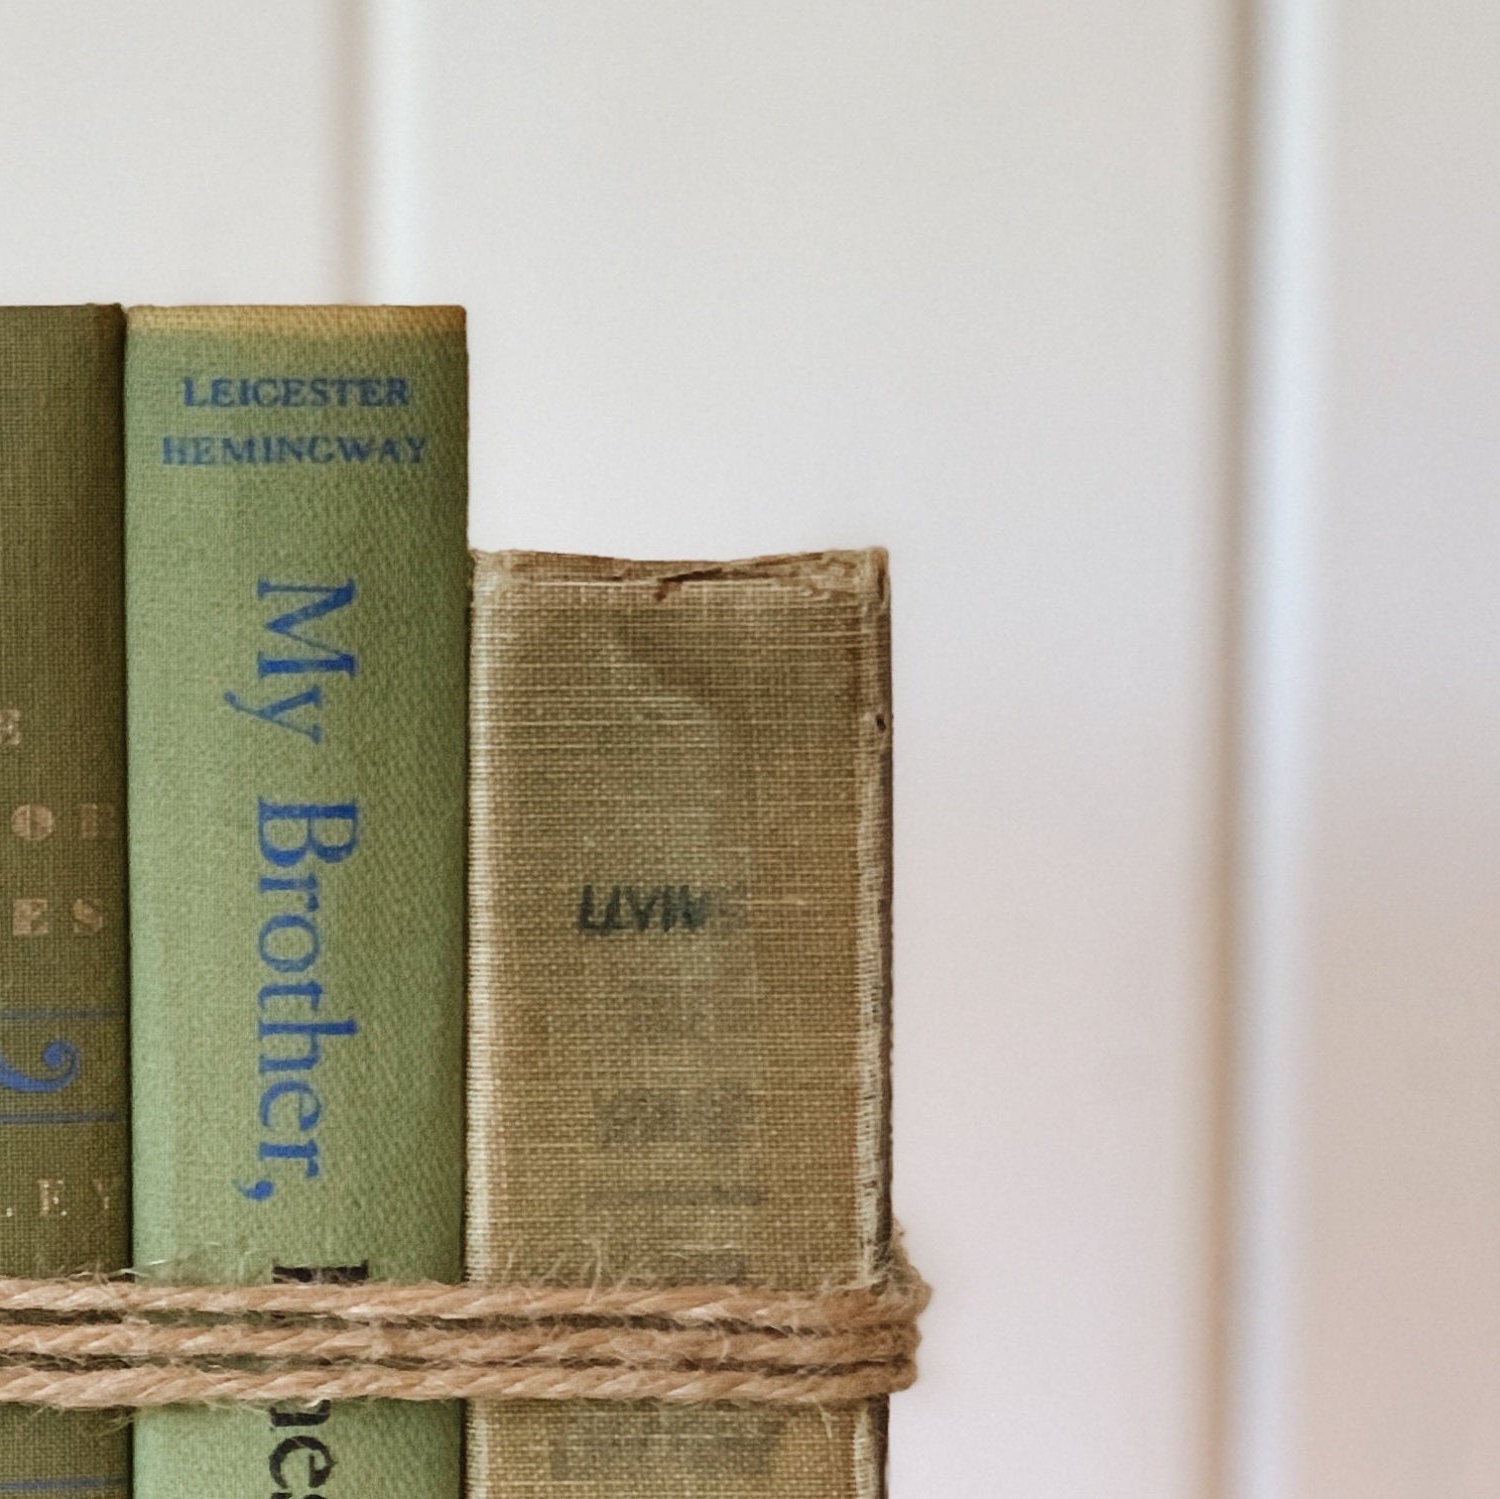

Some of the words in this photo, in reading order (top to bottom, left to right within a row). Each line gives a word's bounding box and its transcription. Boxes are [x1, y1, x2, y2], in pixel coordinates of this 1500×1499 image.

[181, 374, 411, 408] LEICESTER
[161, 434, 427, 467] HEMINGWAY
[222, 577, 358, 746] My
[231, 795, 360, 1202] Brother,
